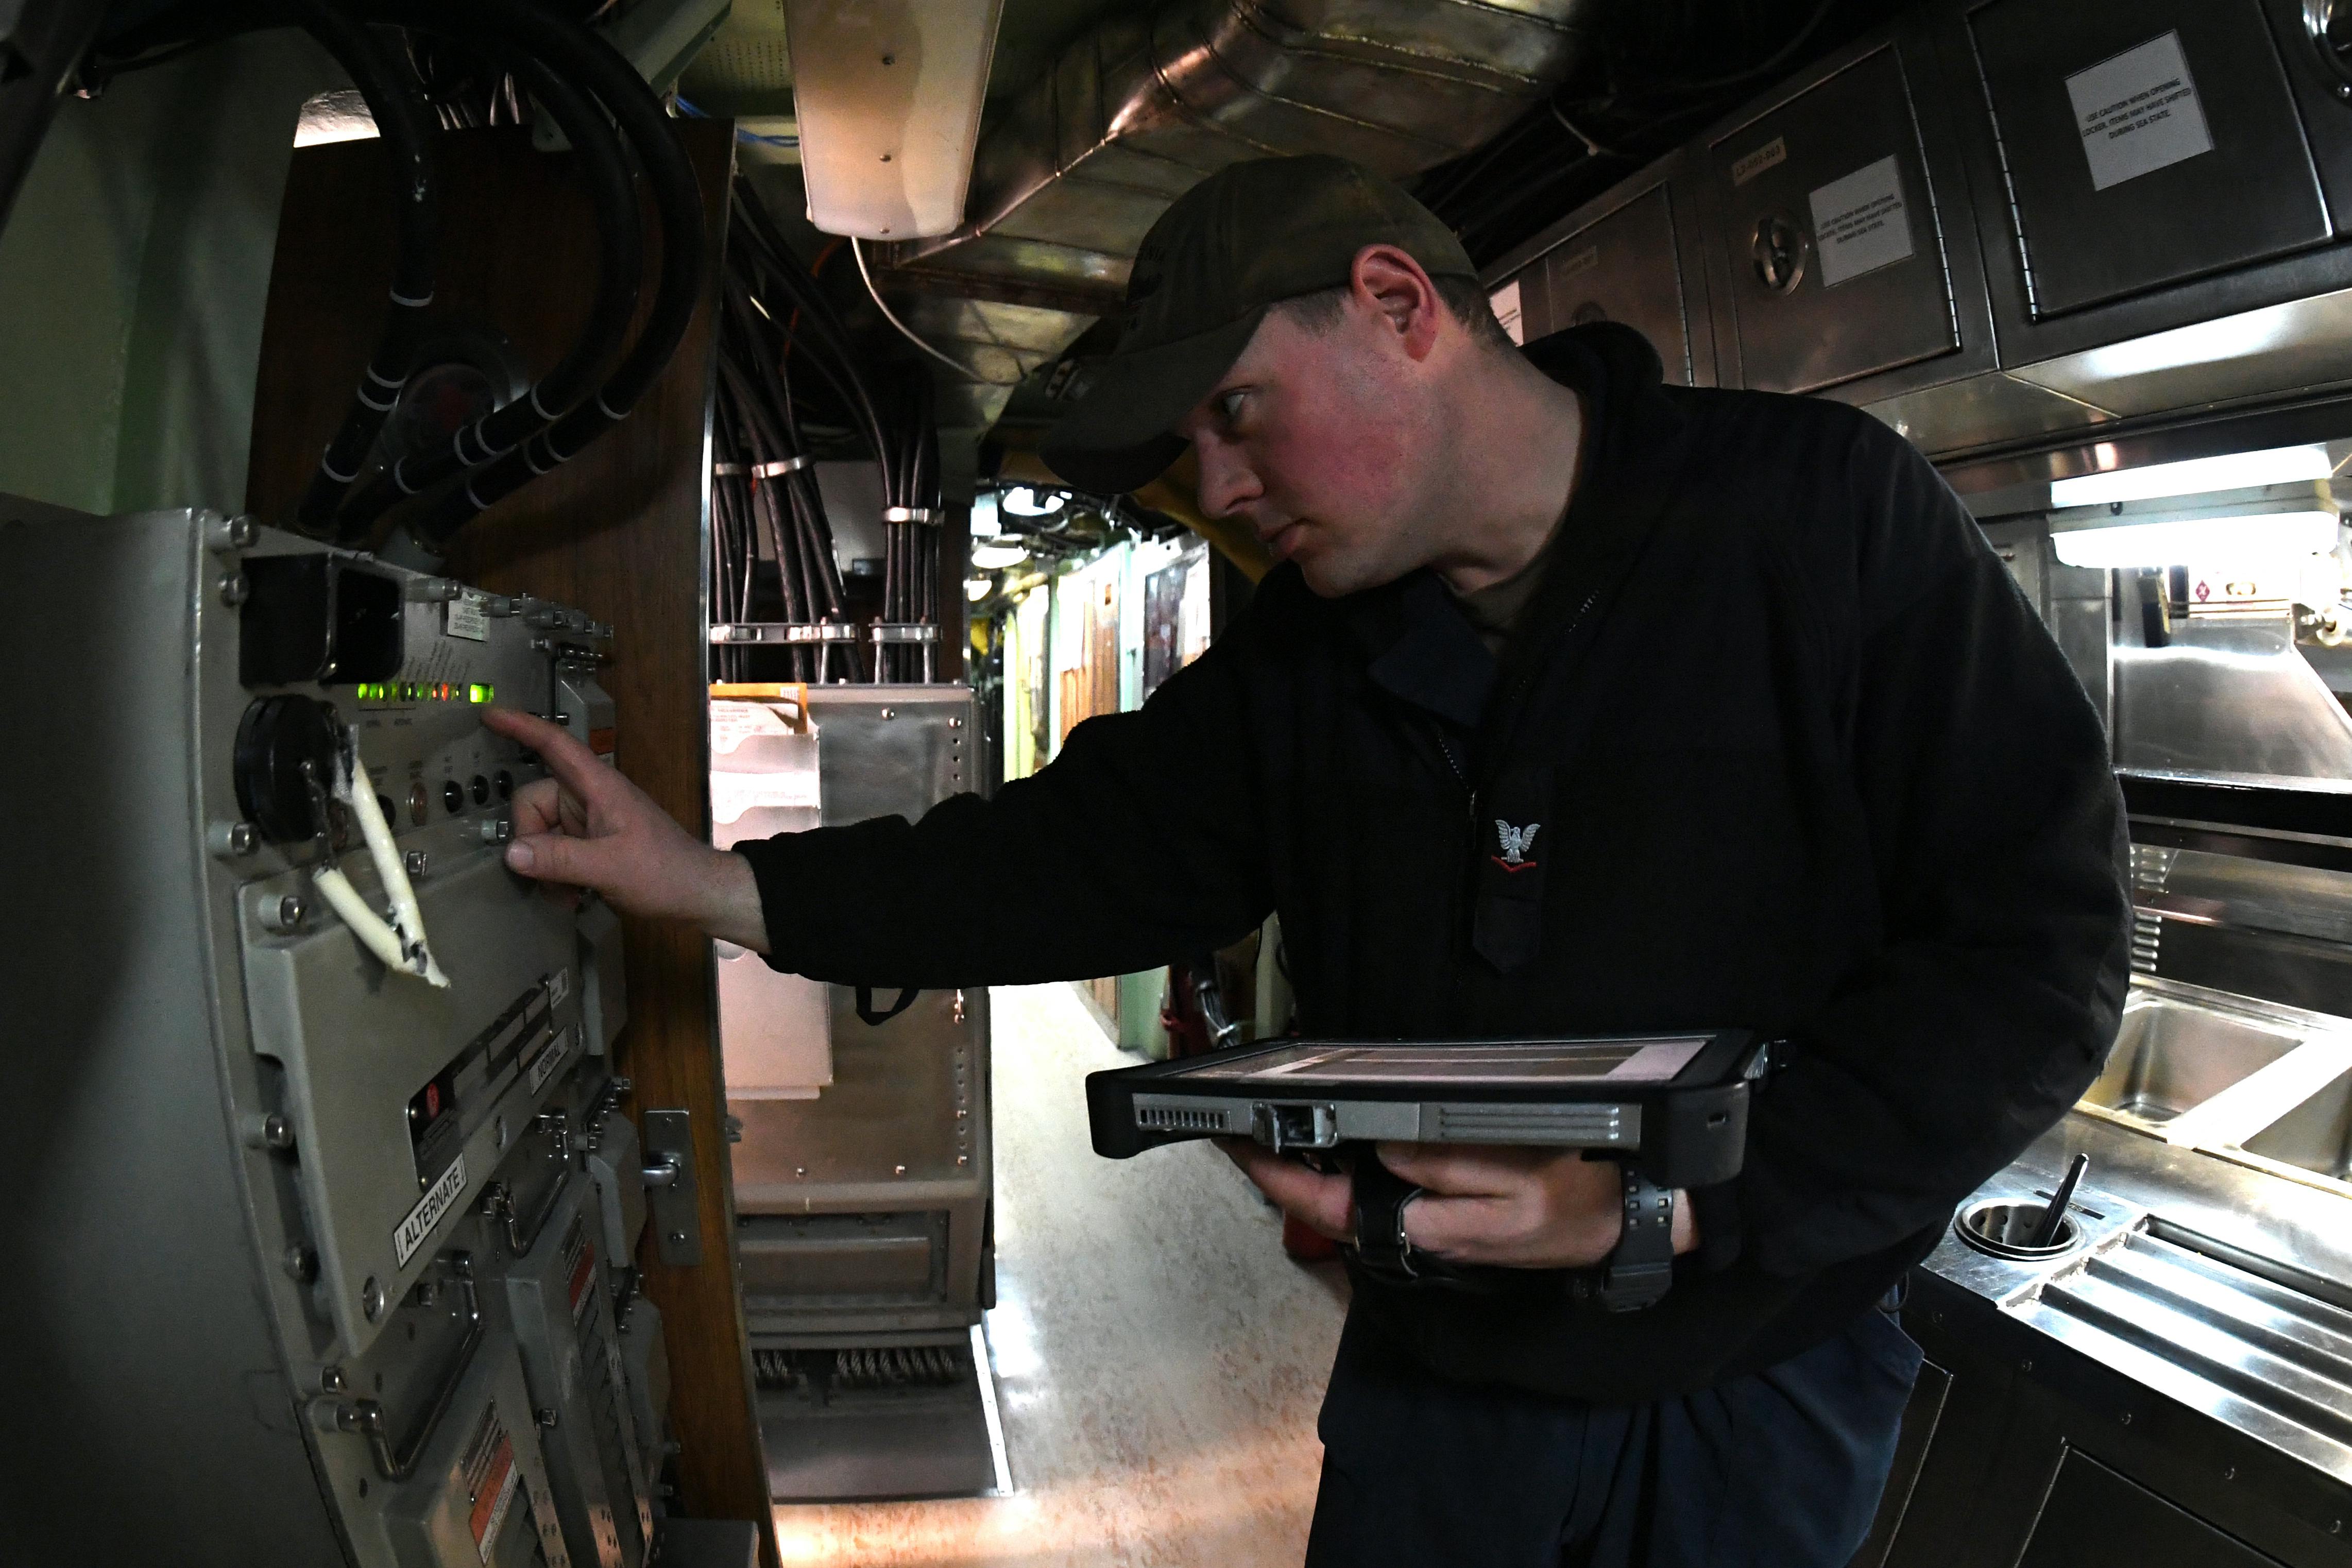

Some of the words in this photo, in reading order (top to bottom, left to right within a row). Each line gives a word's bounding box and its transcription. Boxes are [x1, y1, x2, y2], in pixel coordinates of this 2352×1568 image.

[2086, 112, 2099, 122] USE
[2099, 101, 2128, 117] CAUTION
[2129, 92, 2150, 104] WHEN
[2150, 78, 2180, 95] OPENING
[2109, 113, 2129, 126] ITEMS
[2129, 107, 2144, 117] MAY
[2145, 98, 2164, 110] HAVE
[2164, 87, 2192, 103] SHIFTED
[2109, 124, 2135, 139] DURING
[2136, 120, 2149, 128] SEA
[538, 1042, 560, 1081] NORMAL
[405, 1166, 461, 1252] ALTERNATE
